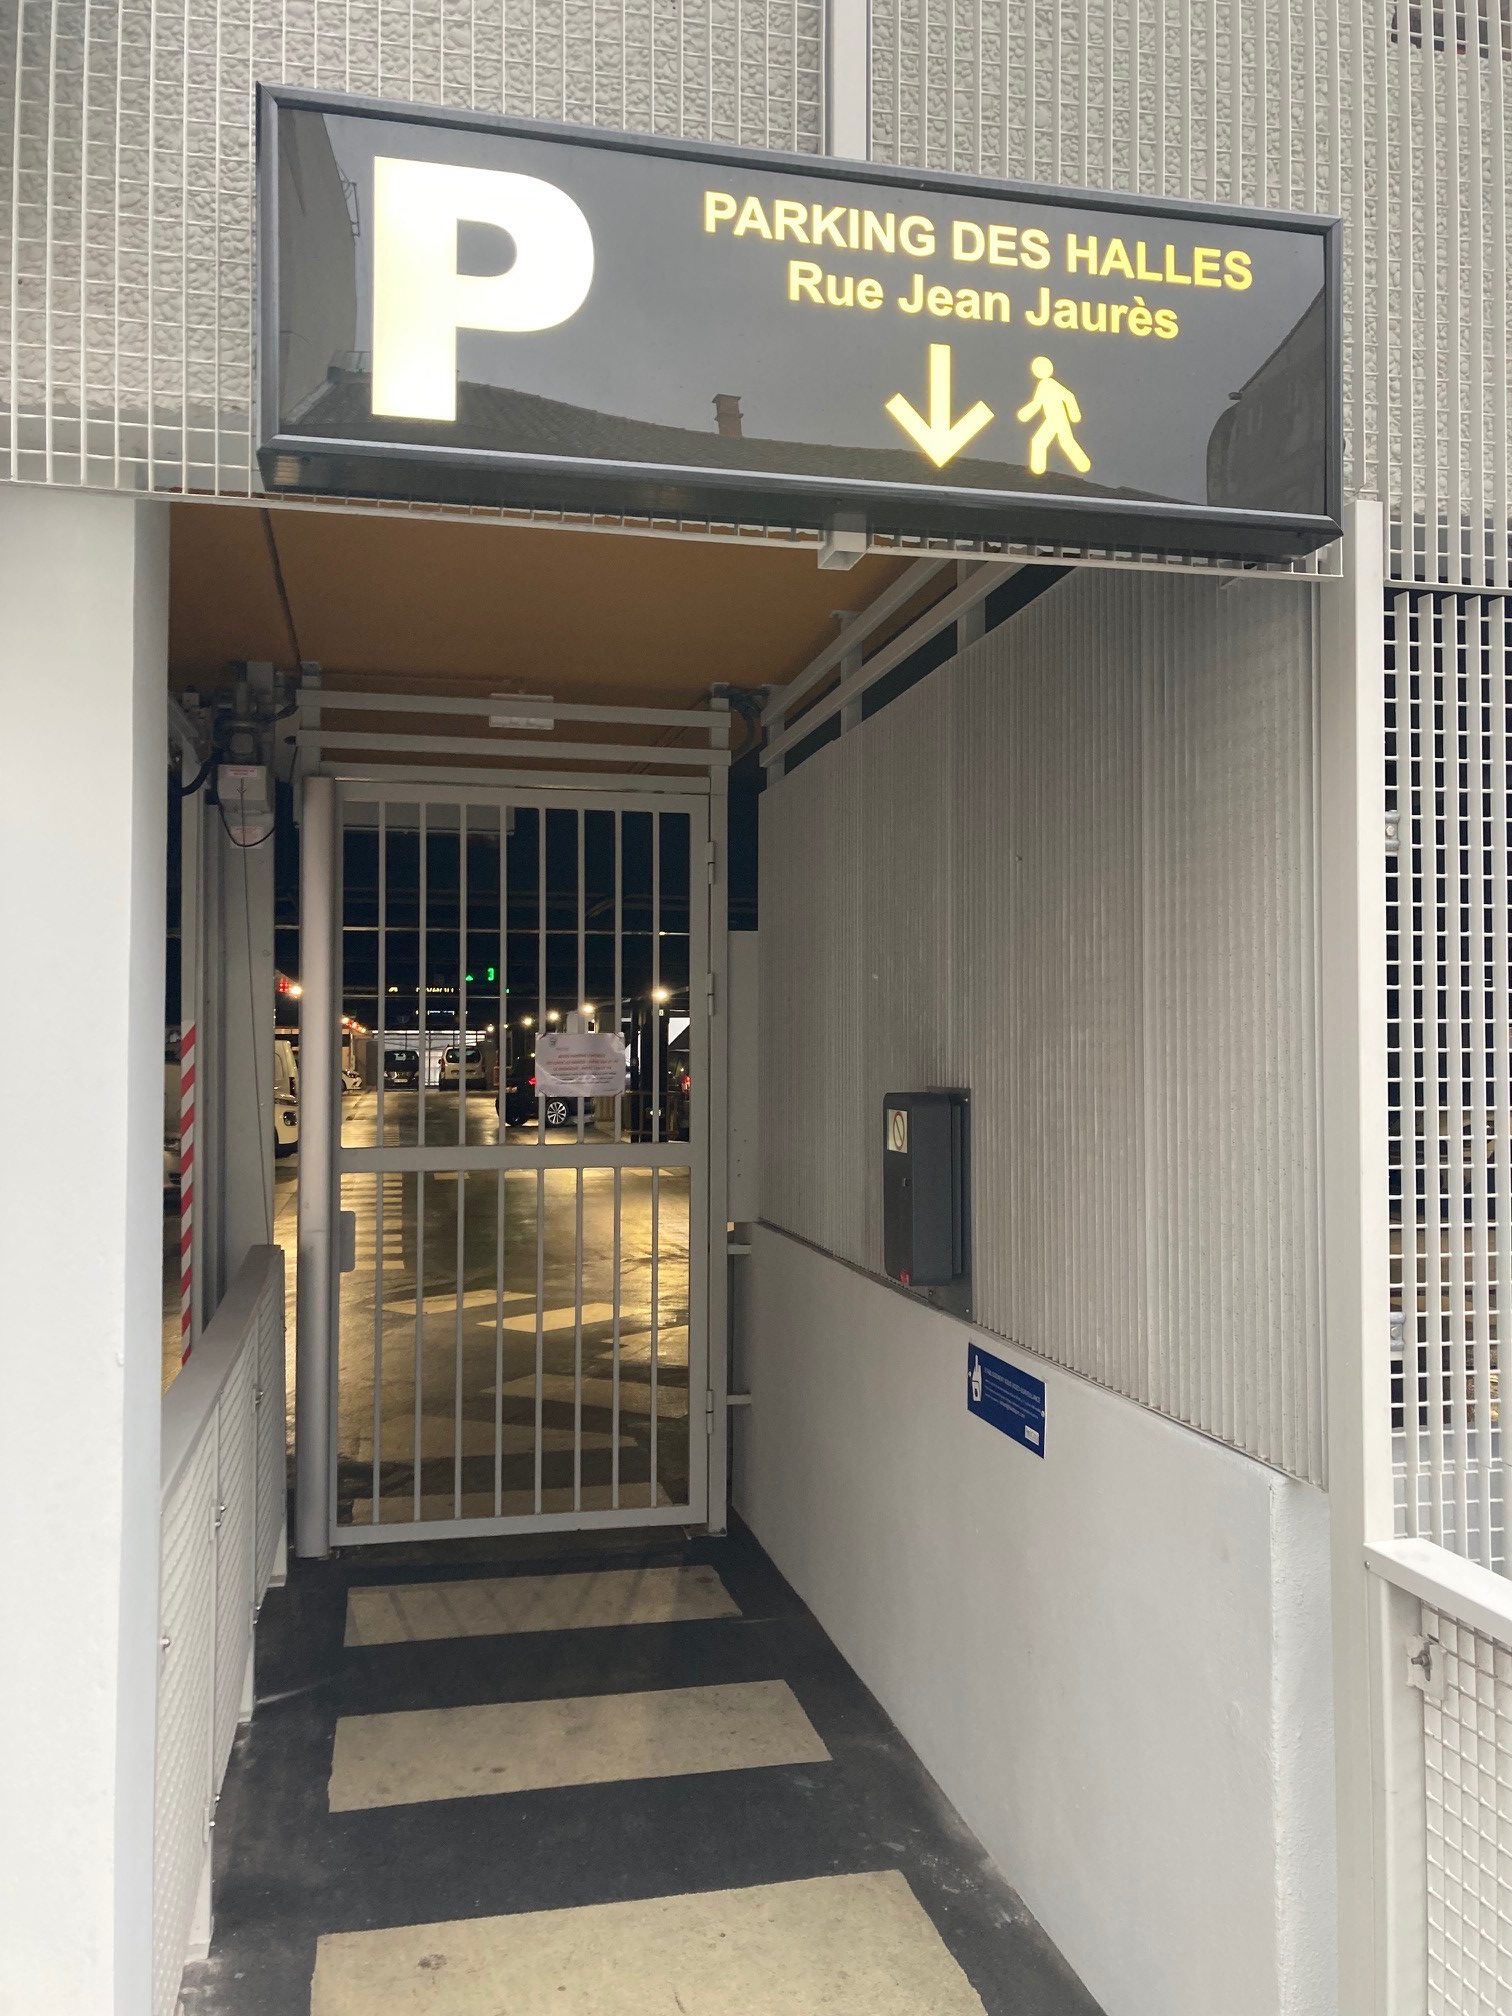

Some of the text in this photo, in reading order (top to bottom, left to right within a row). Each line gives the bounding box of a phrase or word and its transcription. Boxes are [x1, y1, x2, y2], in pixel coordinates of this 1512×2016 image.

[371, 156, 595, 422] P
[703, 190, 1254, 292] PARKING DES HALLES
[787, 258, 1180, 340] Rue Jean Jaurès
